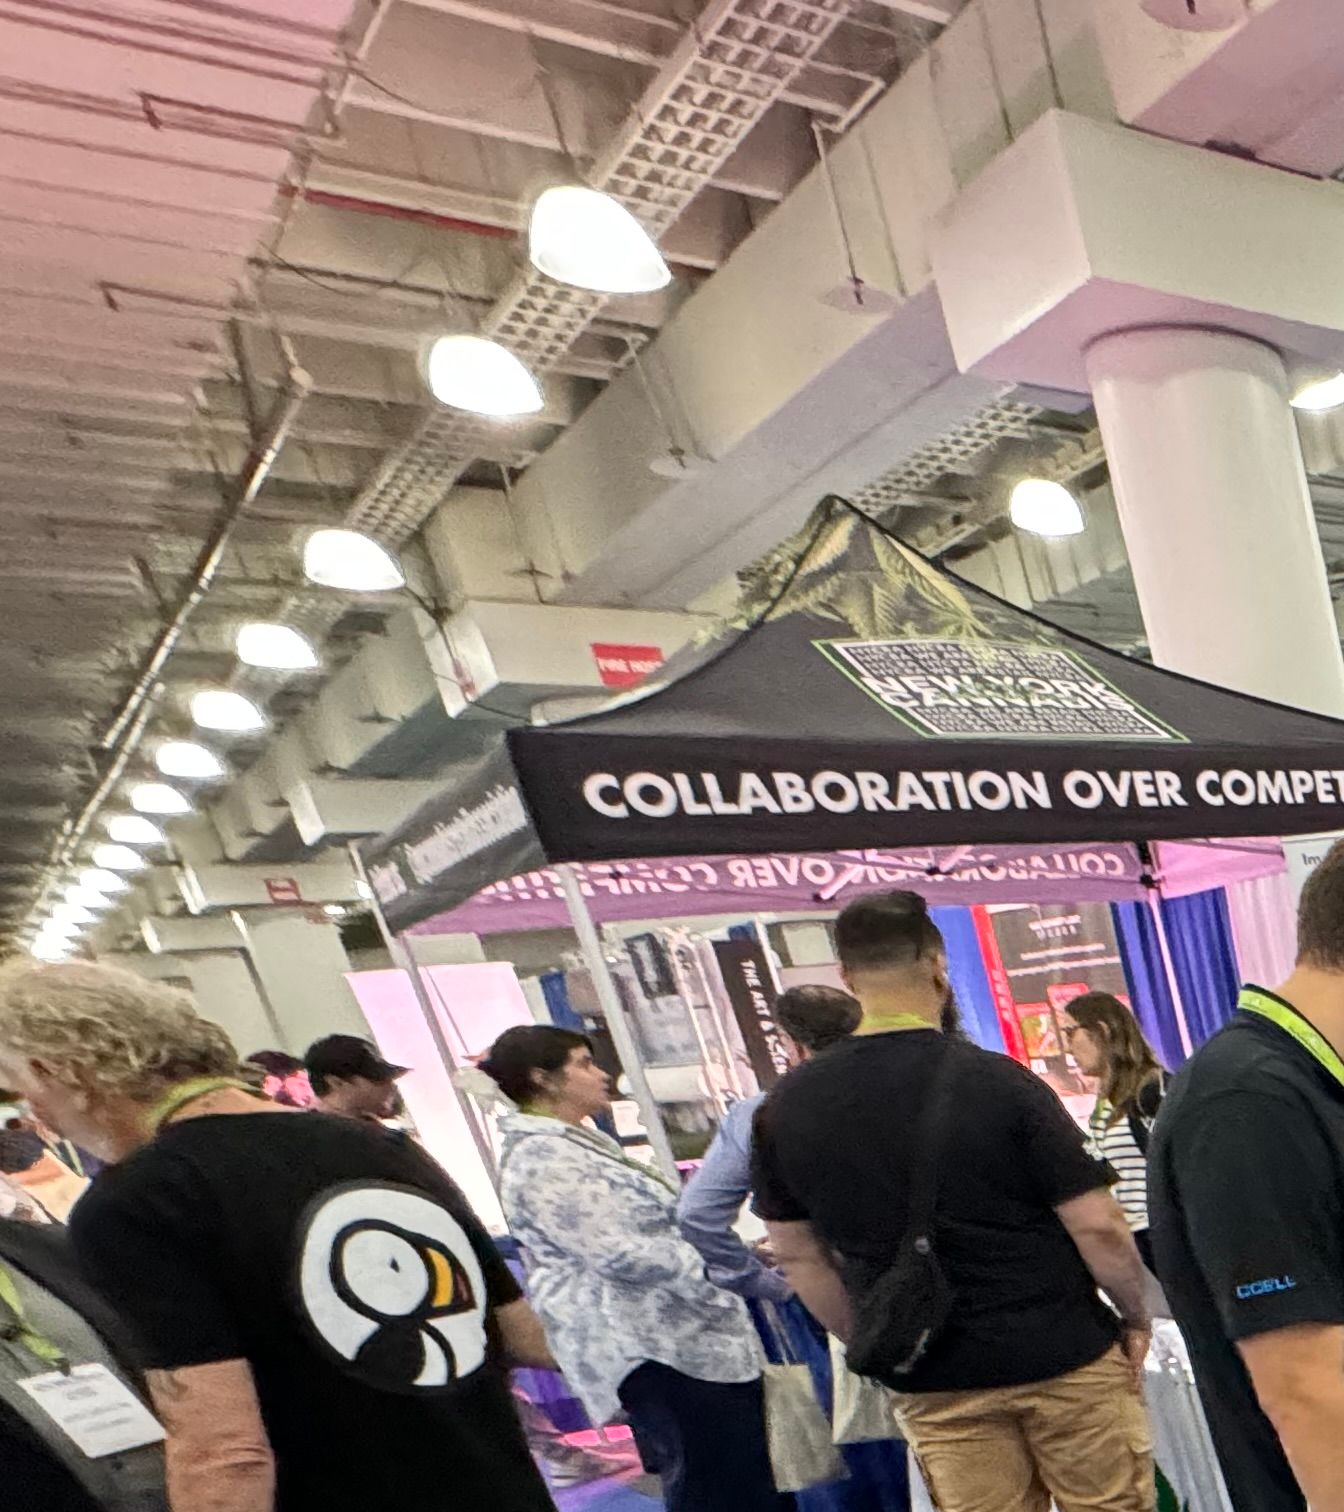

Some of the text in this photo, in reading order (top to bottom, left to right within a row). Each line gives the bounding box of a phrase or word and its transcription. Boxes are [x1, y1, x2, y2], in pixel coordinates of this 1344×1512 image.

[859, 674, 1123, 702] NEW YORK
[583, 768, 1055, 820] COLLABORATION
[1063, 768, 1186, 810] OVER
[1236, 1275, 1297, 1300] CCELL
